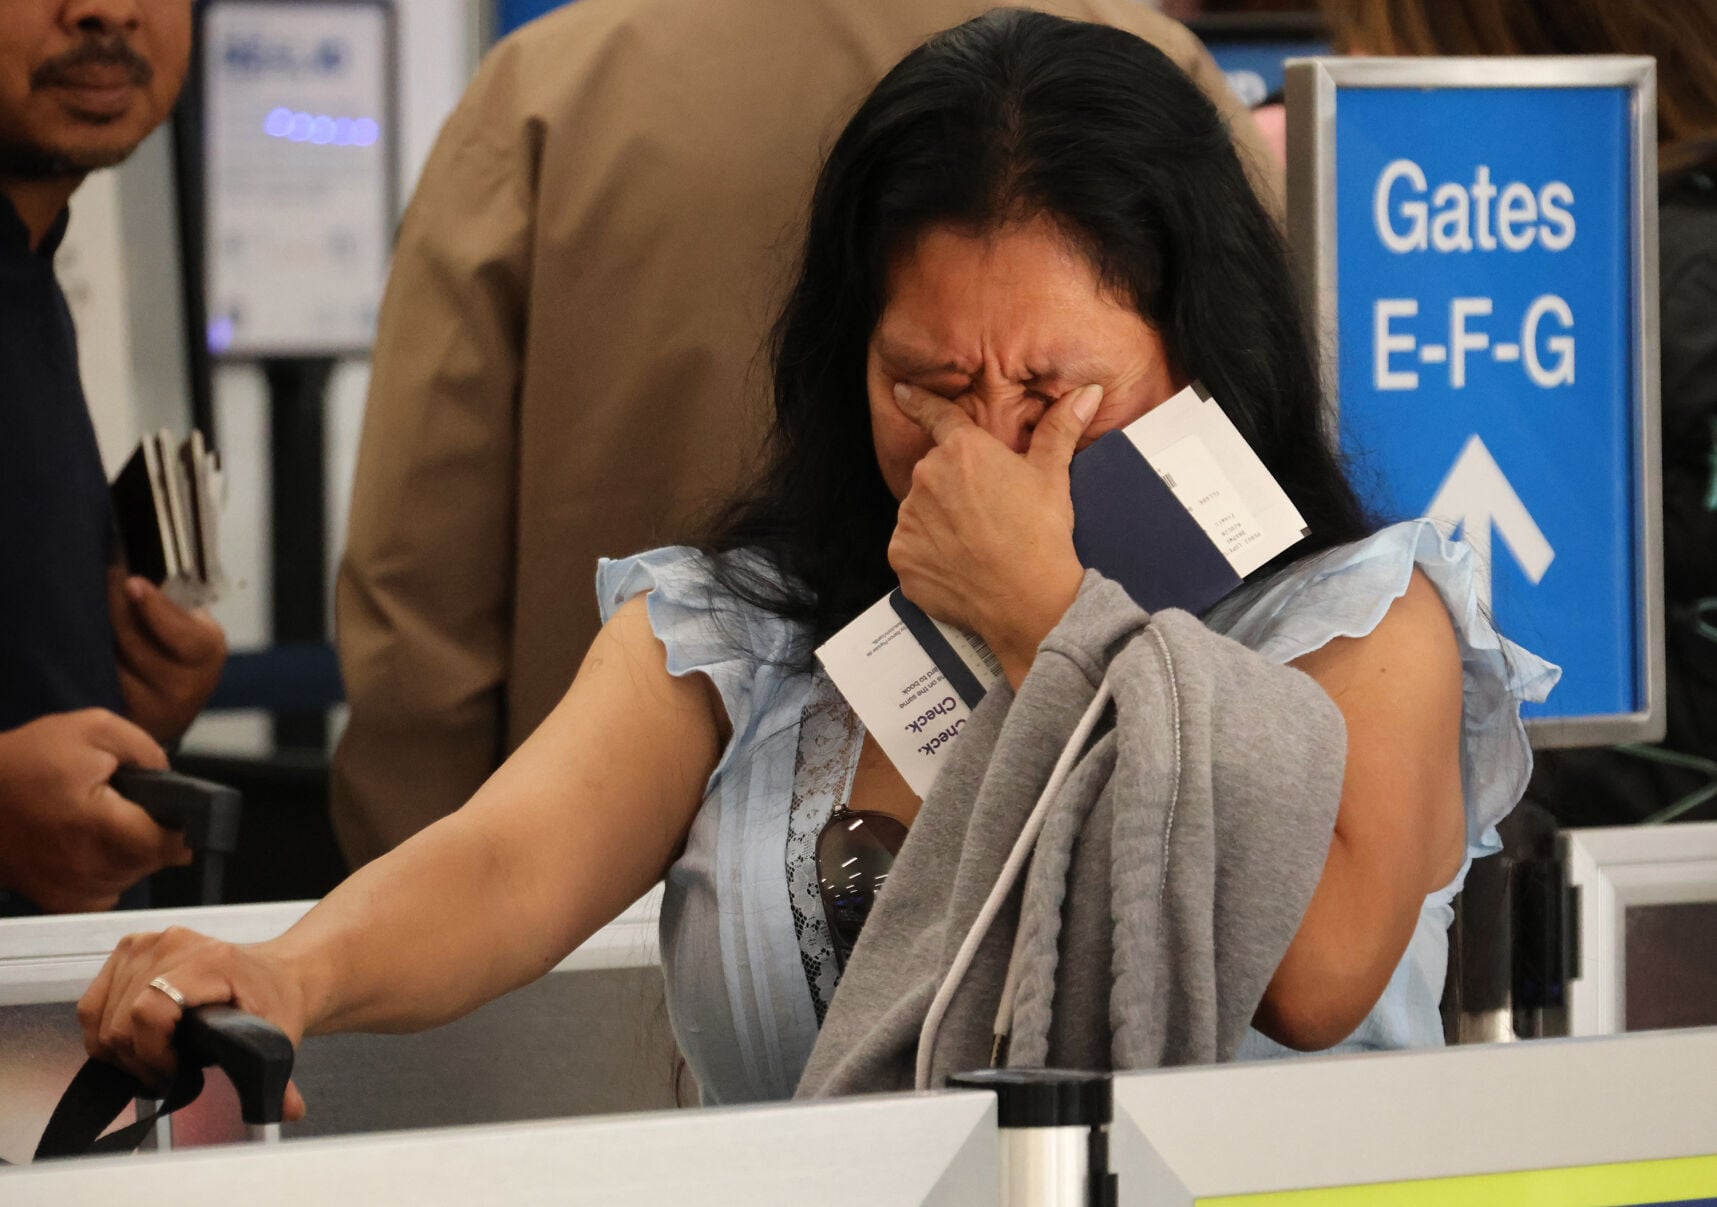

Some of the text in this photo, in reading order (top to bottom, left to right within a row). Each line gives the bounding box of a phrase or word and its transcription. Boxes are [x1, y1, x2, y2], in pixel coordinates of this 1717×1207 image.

[1374, 159, 1576, 253] Gates
[1374, 294, 1576, 390] E-F-G
[919, 675, 928, 683] to
[927, 680, 937, 689] on
[902, 680, 920, 694] book
[917, 686, 929, 696] the
[899, 694, 917, 709] same
[905, 697, 957, 733] Check.
